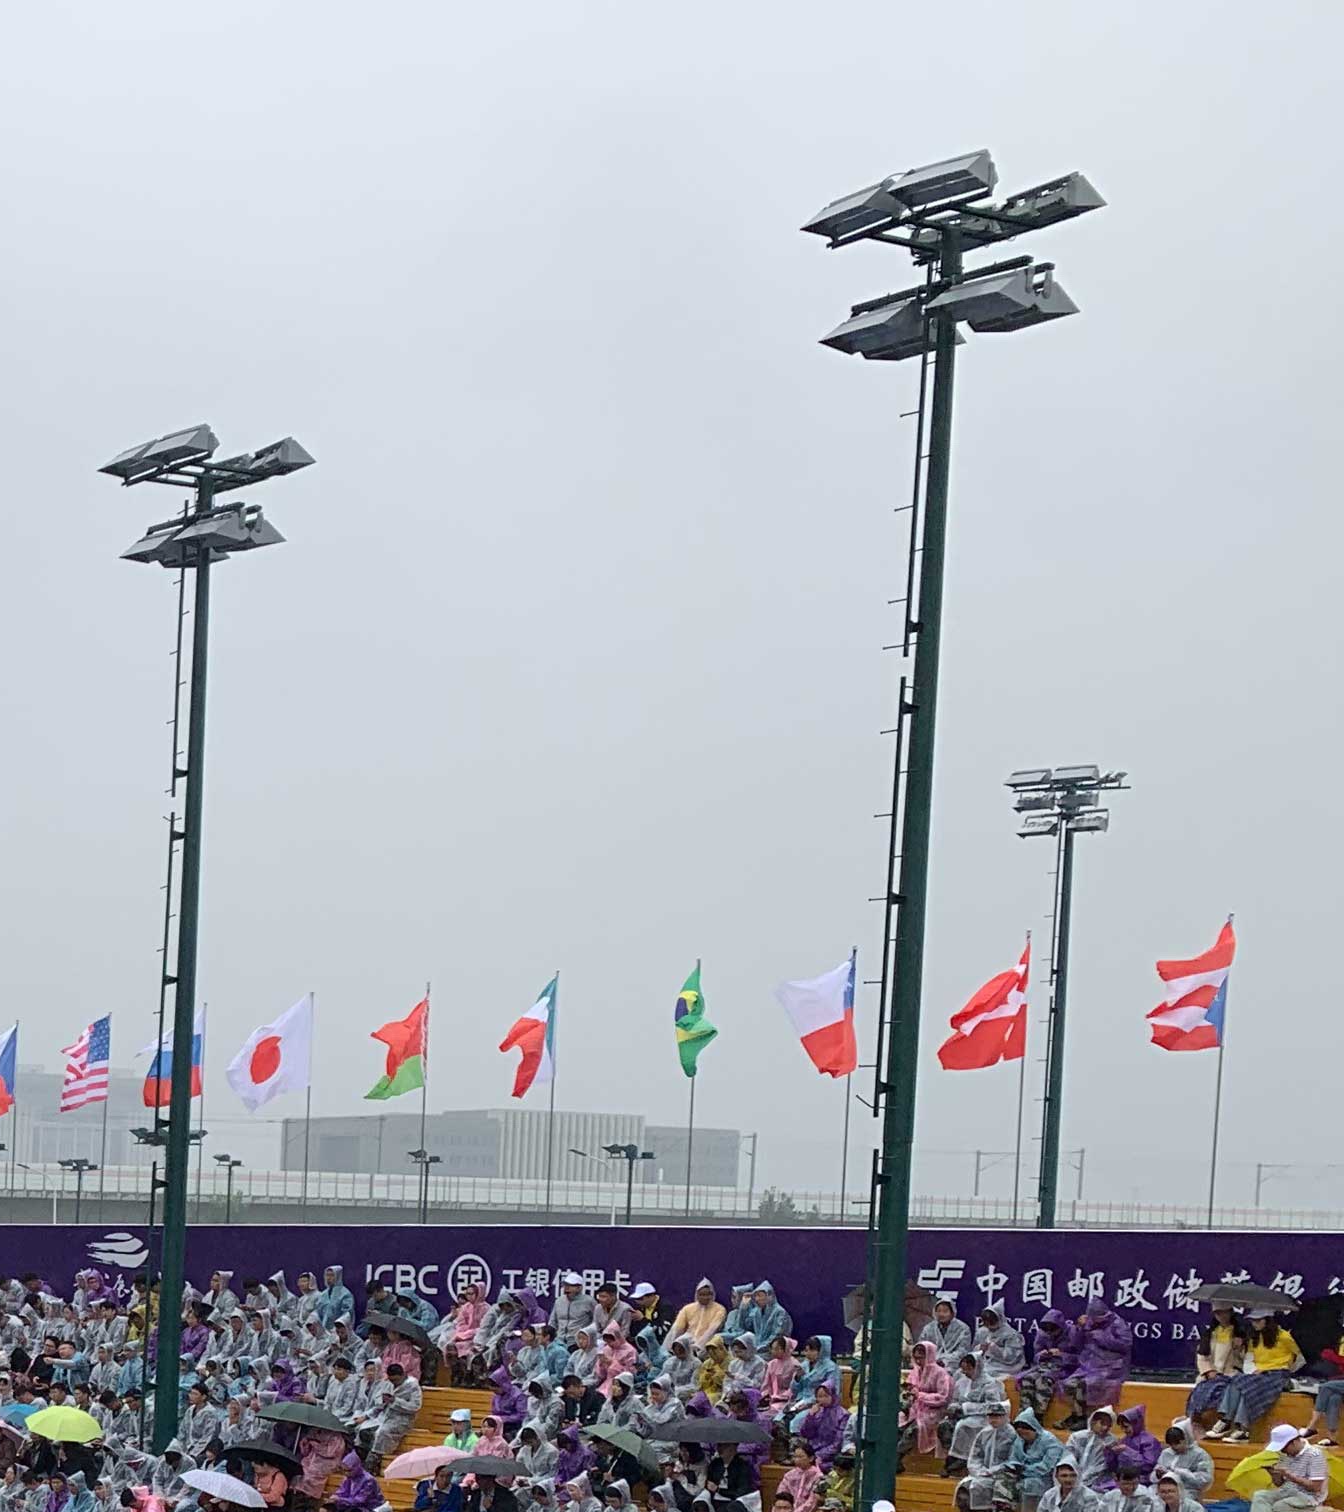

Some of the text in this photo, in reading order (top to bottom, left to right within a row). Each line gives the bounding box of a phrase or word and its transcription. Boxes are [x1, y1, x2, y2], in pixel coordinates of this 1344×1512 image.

[977, 1264, 1344, 1313] 中国邮政储银
